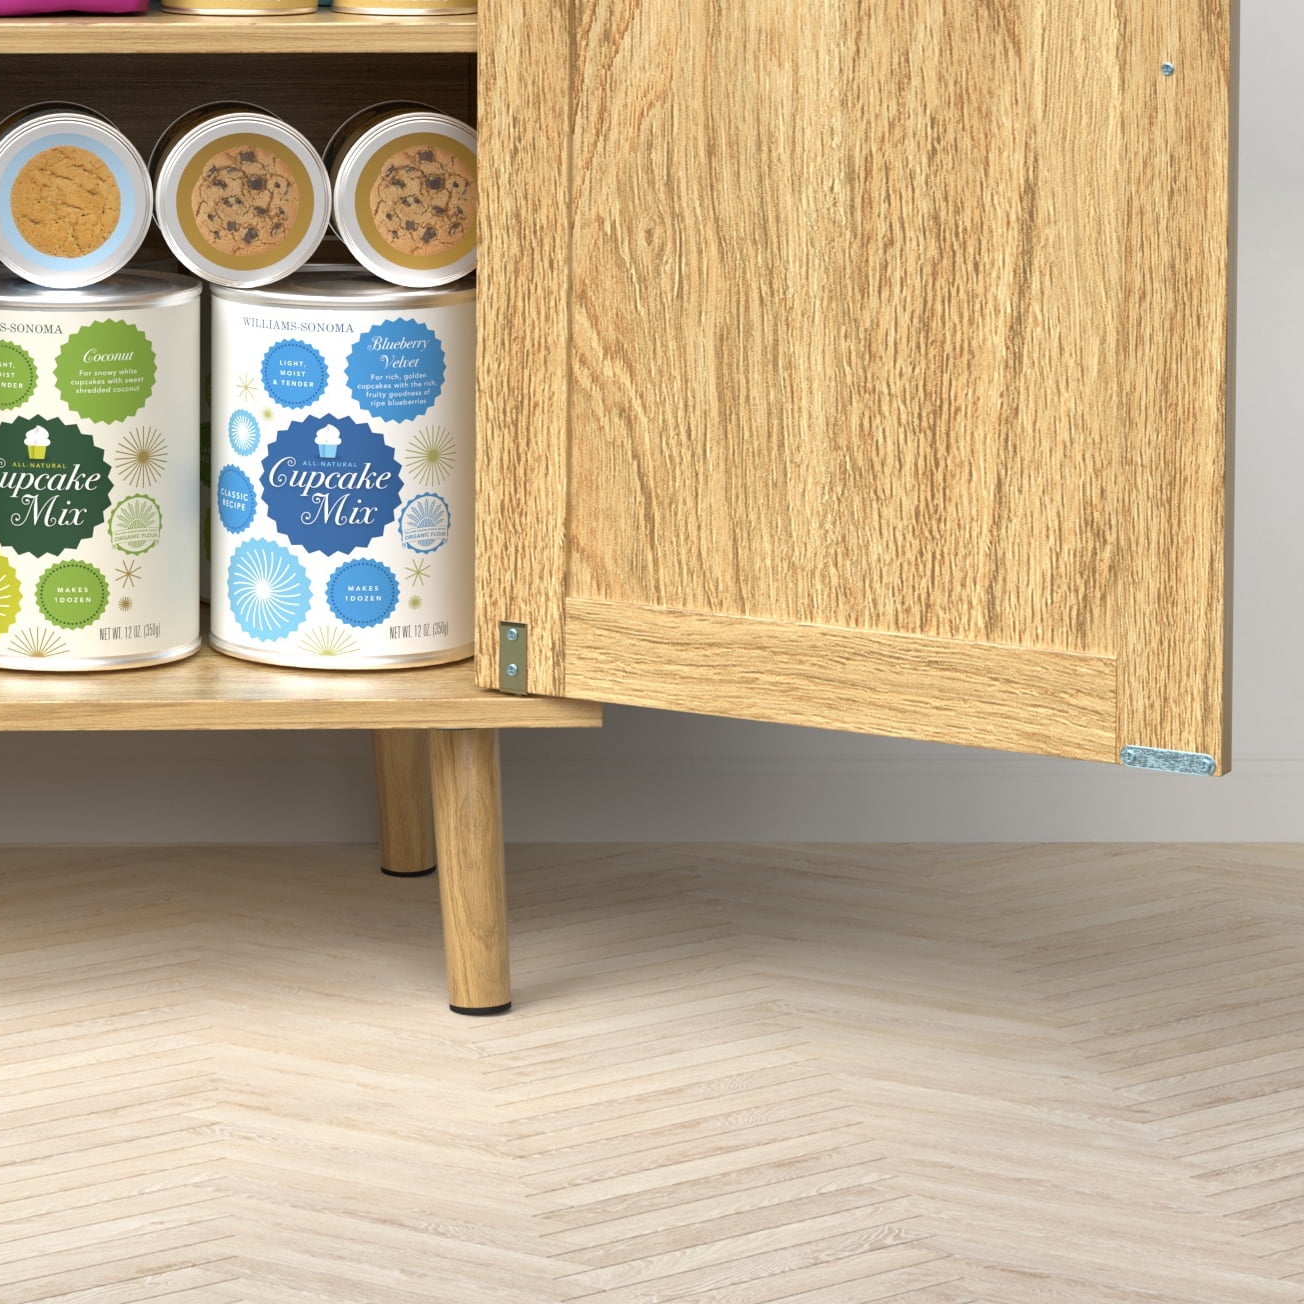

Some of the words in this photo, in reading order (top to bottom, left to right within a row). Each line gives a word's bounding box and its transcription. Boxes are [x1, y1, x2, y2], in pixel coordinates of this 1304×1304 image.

[243, 316, 354, 333] WILLIAMS-SONOMA
[367, 336, 430, 352] Blueberry
[83, 348, 134, 364] Coconut
[279, 360, 307, 368] LIGHT,
[380, 354, 420, 370] Velvet
[79, 369, 91, 377] For
[119, 368, 137, 376] white
[370, 373, 382, 381] For
[403, 372, 427, 381] golden
[71, 378, 105, 386] cupcakes
[107, 377, 122, 385] with
[281, 380, 314, 388] TENDER
[357, 383, 392, 391] cupcakes
[394, 381, 409, 389] with
[76, 386, 111, 394] shredded
[366, 391, 386, 399] fruity
[388, 390, 422, 398] goodness
[370, 400, 386, 408] ripe
[387, 398, 427, 406] blueberries
[12, 461, 67, 469] ALL-NATURAL
[302, 460, 358, 468] ALL-NATURAL
[268, 456, 392, 497] Cupcake
[220, 487, 249, 502] CLASSIC
[222, 498, 247, 511] RECIPE
[300, 492, 378, 526] Mix
[10, 493, 87, 527] Mix
[115, 533, 140, 542] ORGANIC
[99, 627, 111, 641] NET
[125, 626, 133, 639] 12
[389, 626, 401, 640] NET
[414, 624, 422, 638] 12
